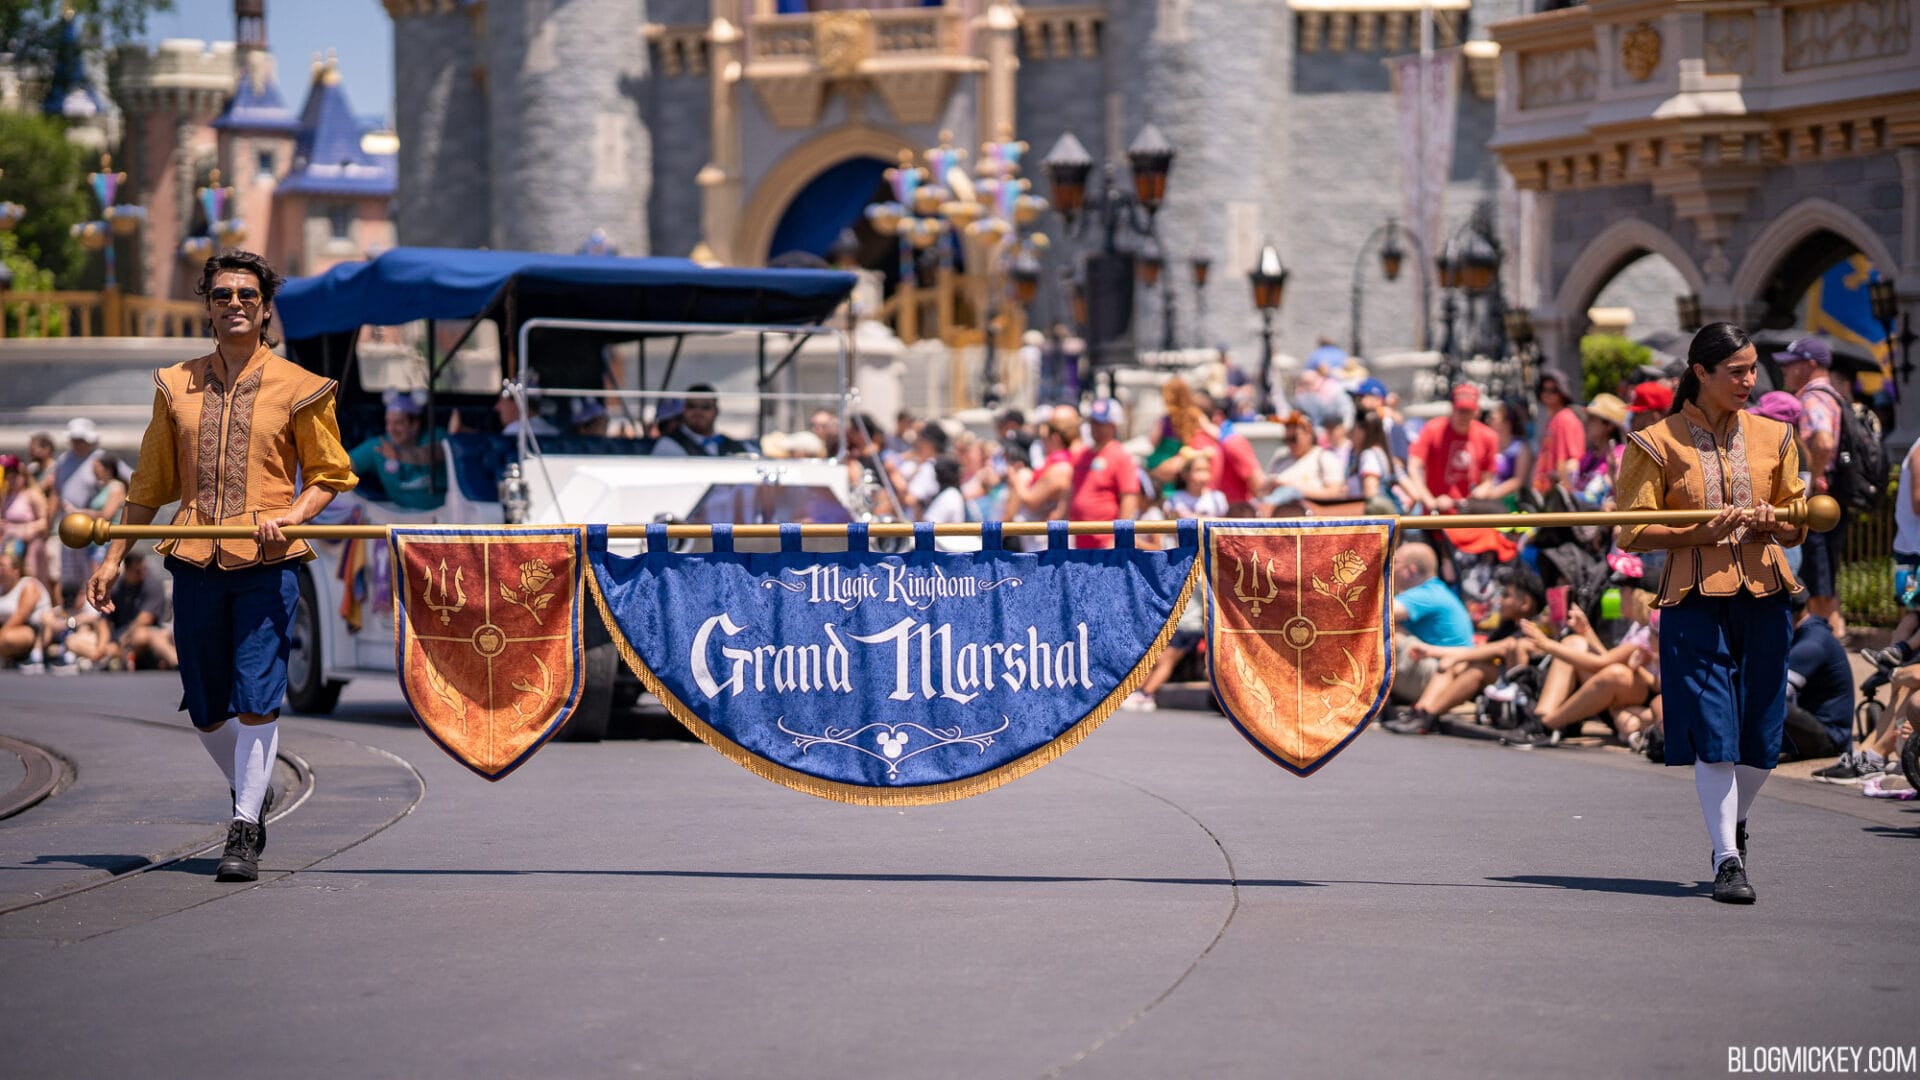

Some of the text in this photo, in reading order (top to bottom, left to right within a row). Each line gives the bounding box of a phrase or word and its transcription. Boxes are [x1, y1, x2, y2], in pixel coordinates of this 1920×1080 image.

[788, 562, 976, 610] Magic Kingdom
[690, 613, 1093, 704] Grand Marshal
